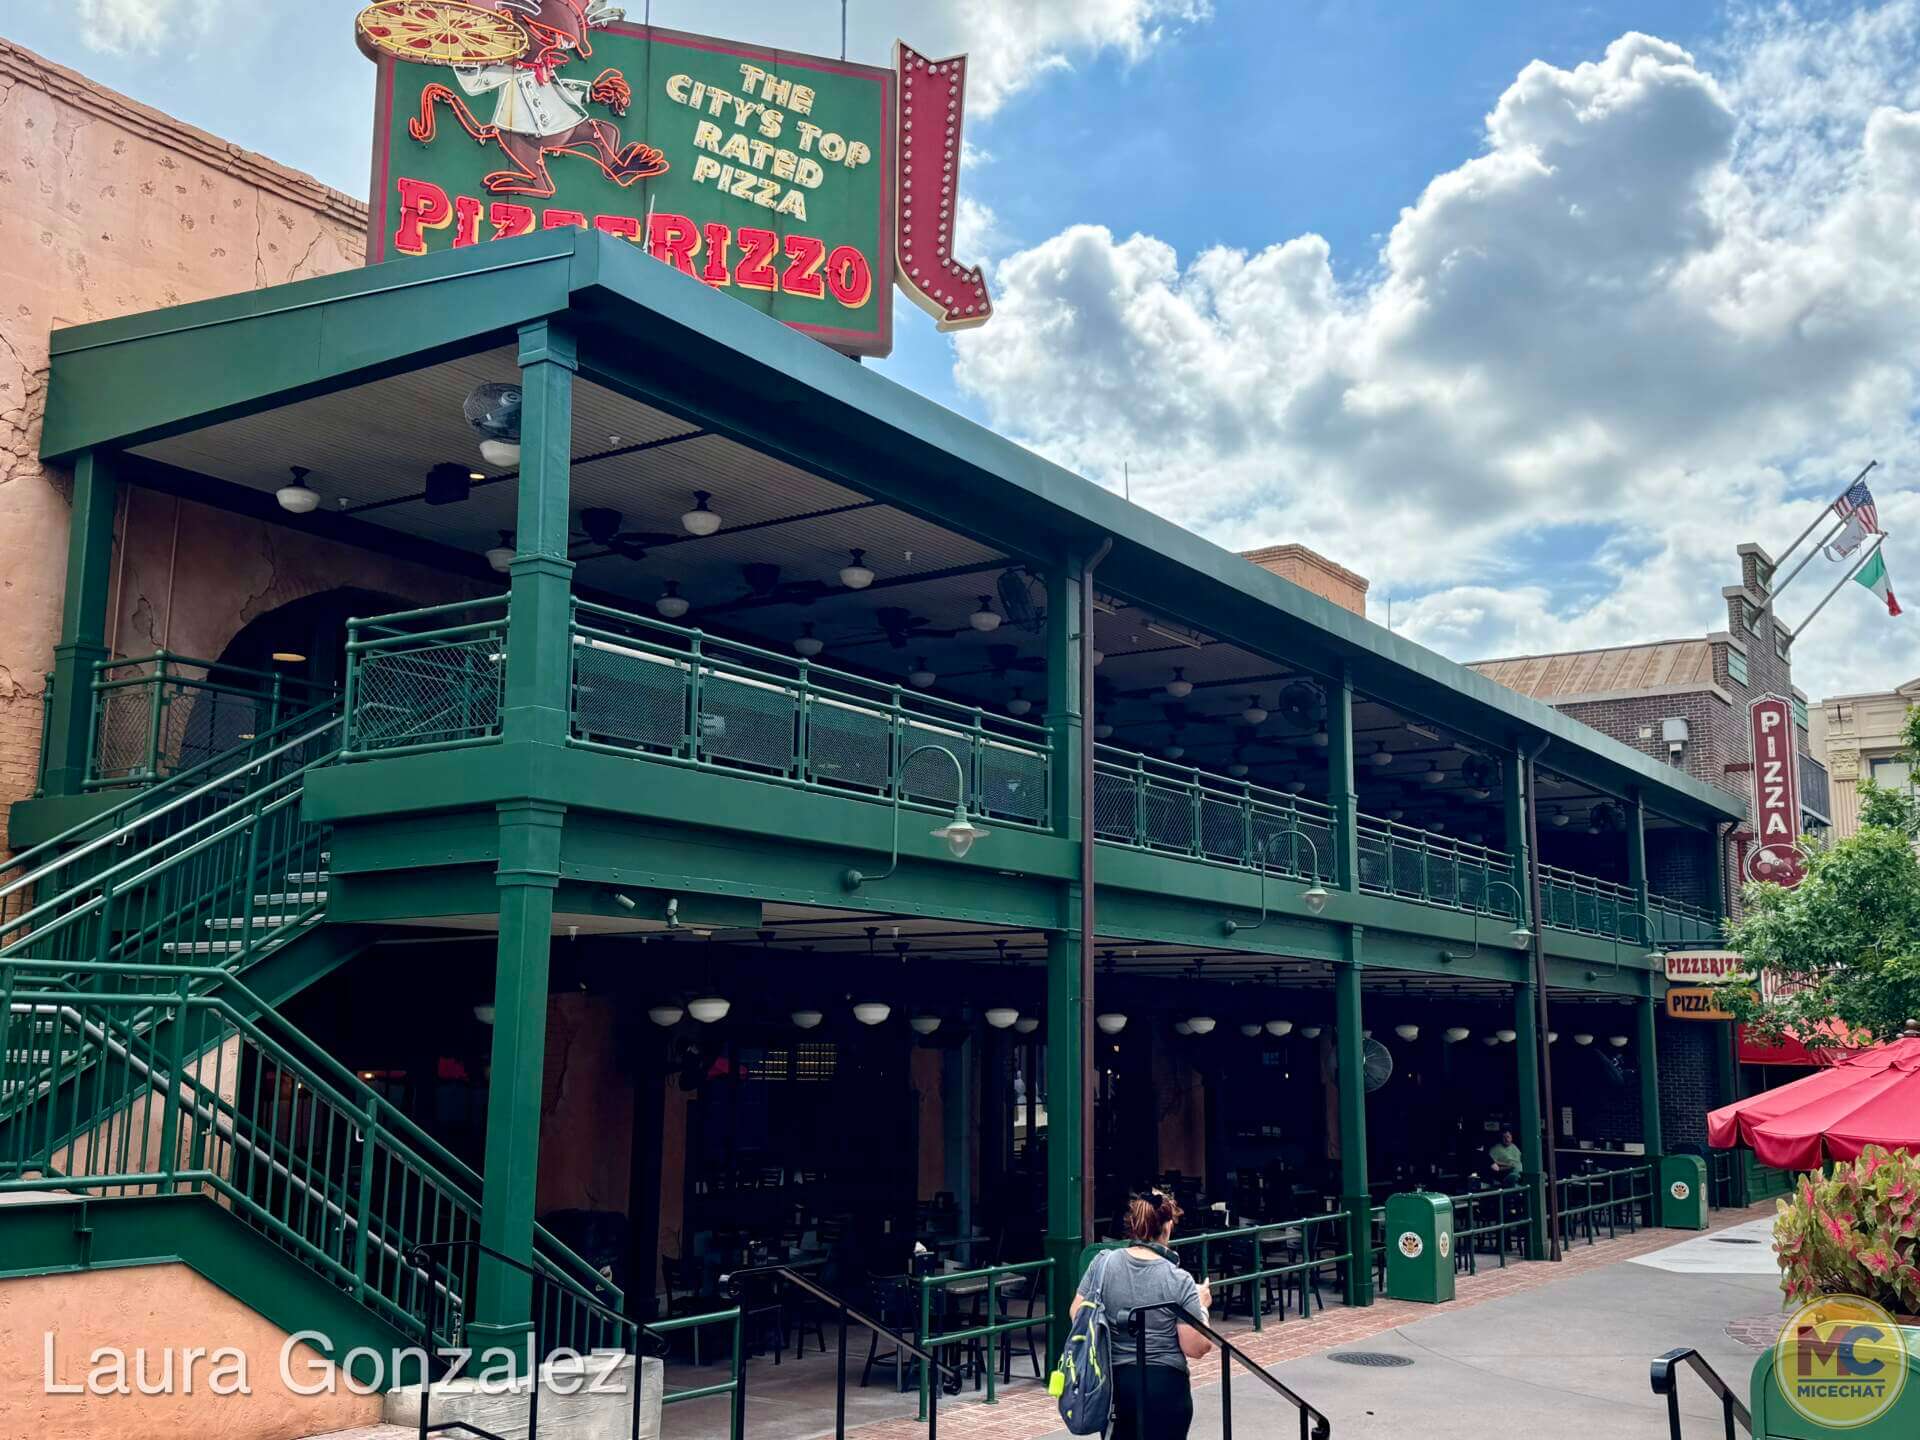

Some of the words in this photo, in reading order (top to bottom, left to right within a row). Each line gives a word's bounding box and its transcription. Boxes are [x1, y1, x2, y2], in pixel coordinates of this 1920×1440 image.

[665, 74, 784, 138] CITY'S
[796, 120, 871, 169] TOP
[739, 63, 816, 117] THE
[692, 154, 807, 222] PIZZA
[693, 119, 824, 189] RATED
[1760, 711, 1789, 835] PIZZA
[1672, 995, 1711, 1012] PIZZA
